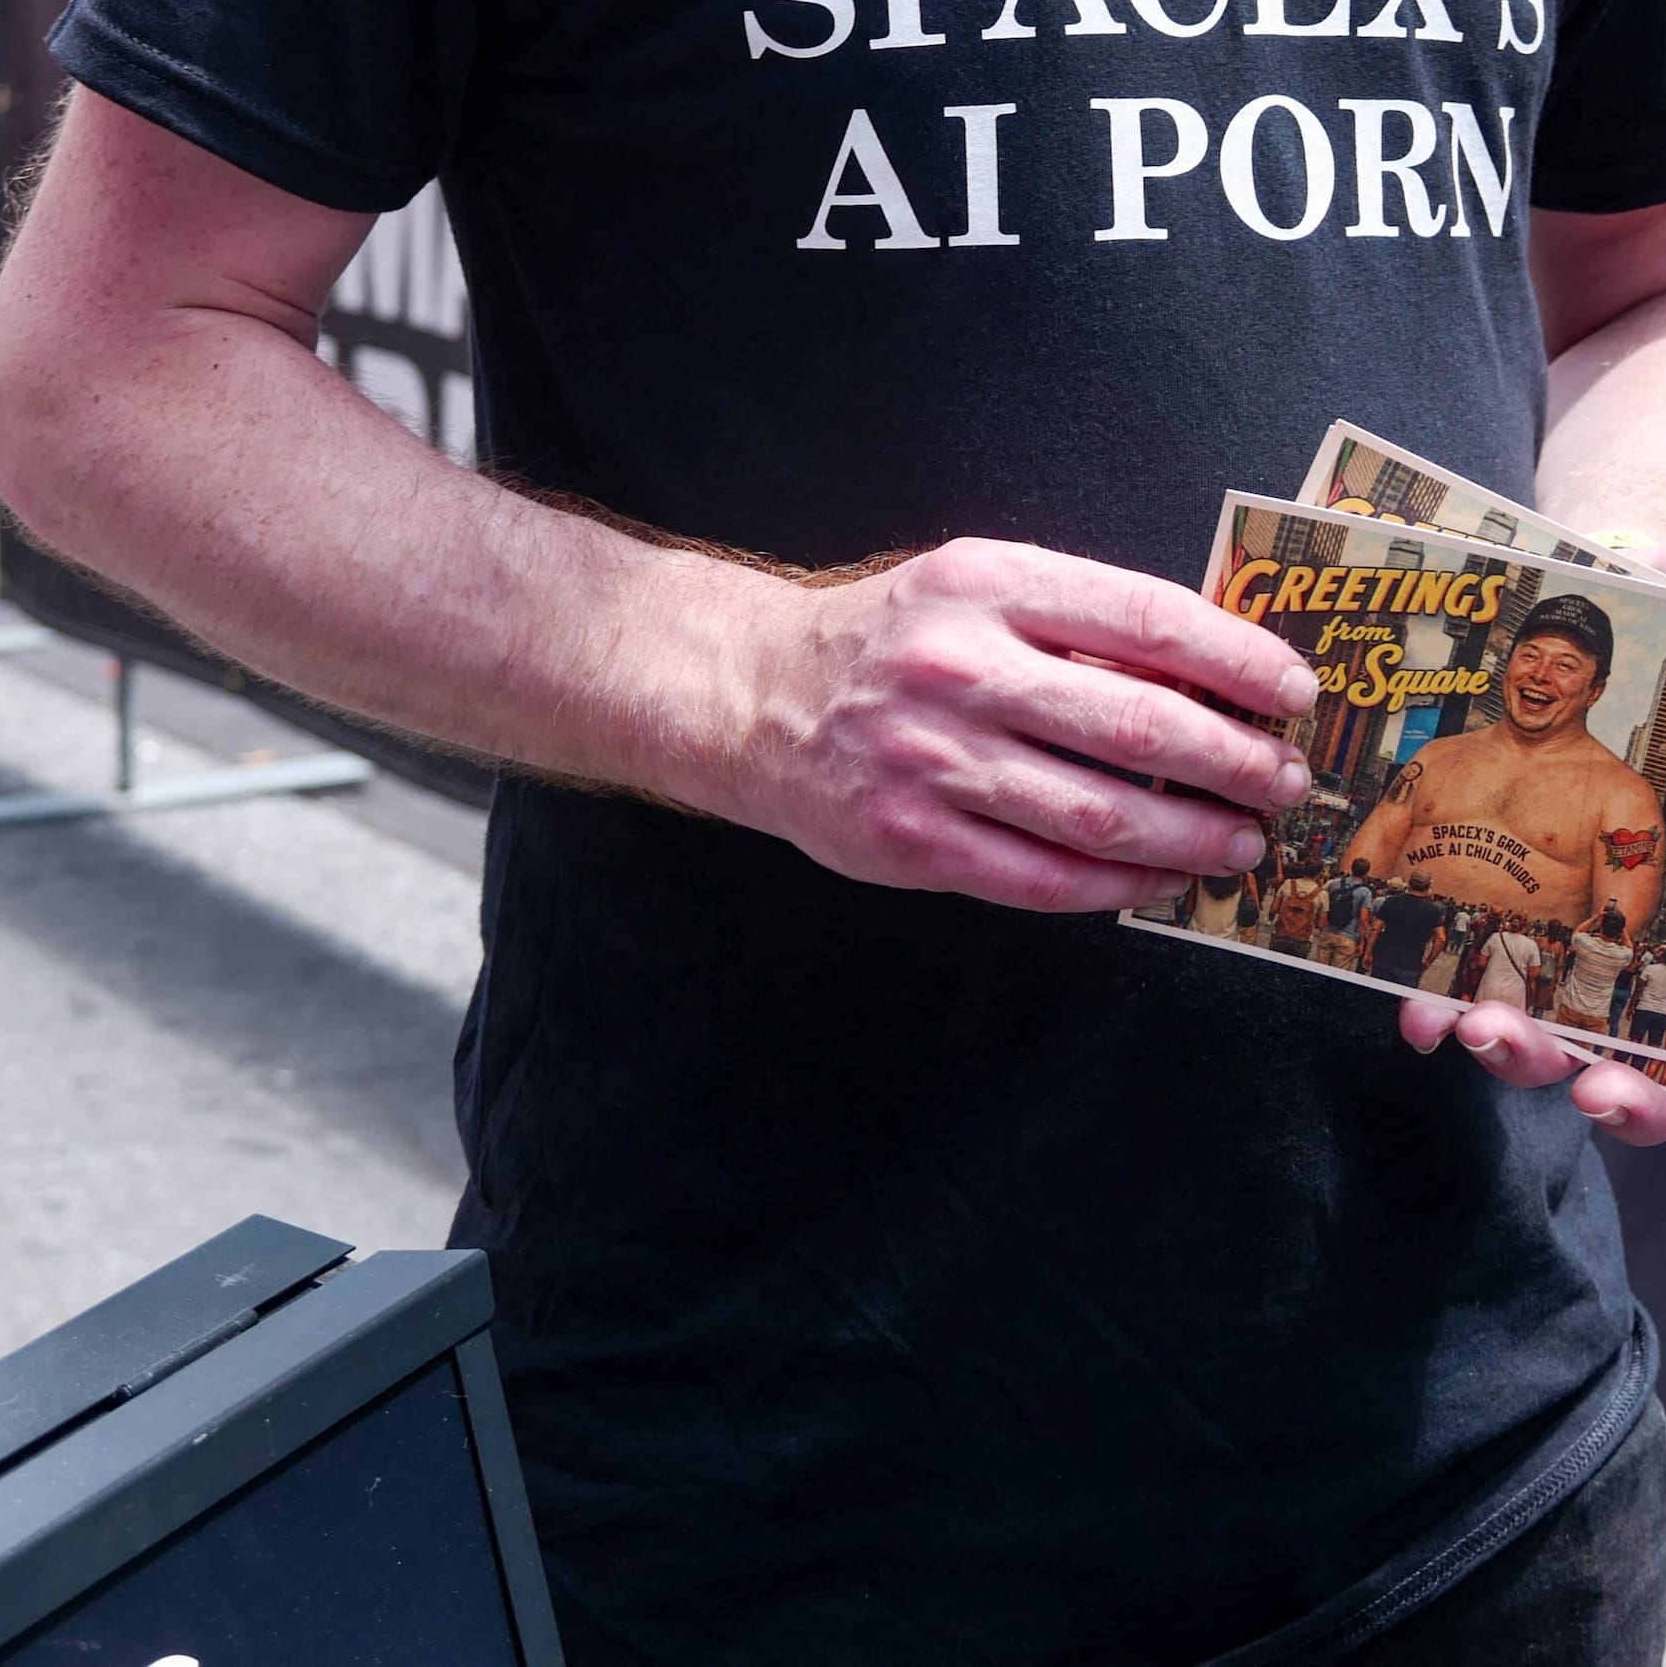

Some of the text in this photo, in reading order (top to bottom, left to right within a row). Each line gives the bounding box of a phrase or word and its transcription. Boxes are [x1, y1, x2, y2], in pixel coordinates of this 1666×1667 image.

[796, 94, 1516, 250] AI PORN
[1222, 558, 1507, 625] GREETINGS
[1315, 615, 1396, 655] from
[1347, 642, 1490, 713] Square
[1406, 842, 1540, 895] MADE AI CHILD NUDES
[1432, 825, 1531, 861] SPACEX'S GROK
